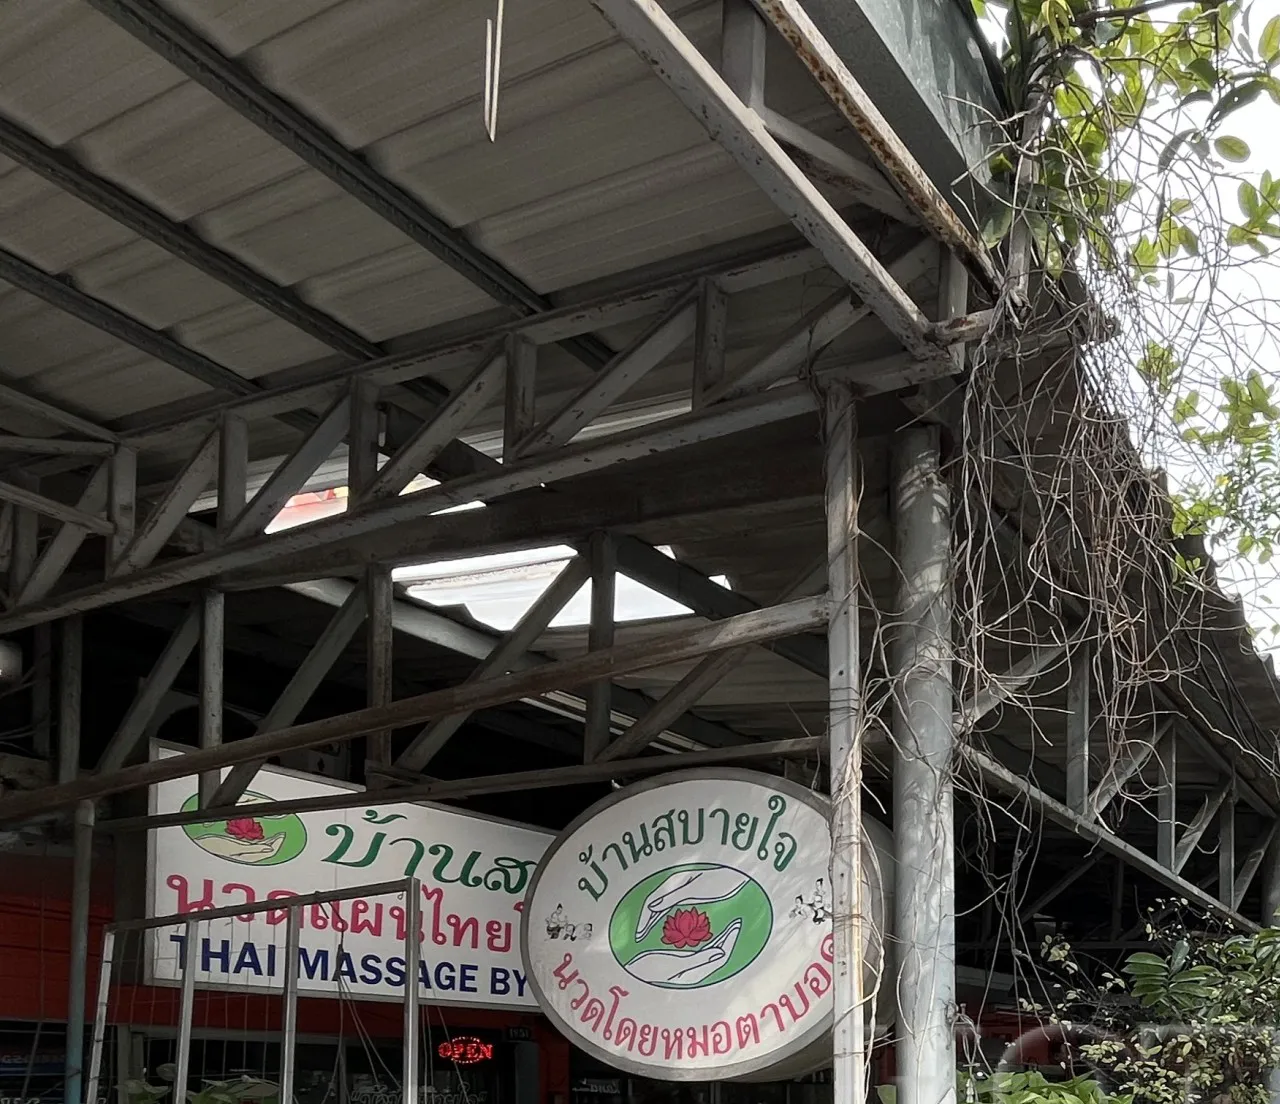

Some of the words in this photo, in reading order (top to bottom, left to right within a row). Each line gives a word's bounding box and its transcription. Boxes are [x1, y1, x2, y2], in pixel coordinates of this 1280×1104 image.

[320, 809, 537, 894] บ้านส
[577, 794, 798, 902] บ้านสบายใจ
[170, 934, 276, 978] THAI
[299, 947, 479, 993] MASSAGE
[490, 964, 528, 998] BY
[437, 1041, 495, 1059] OPEN
